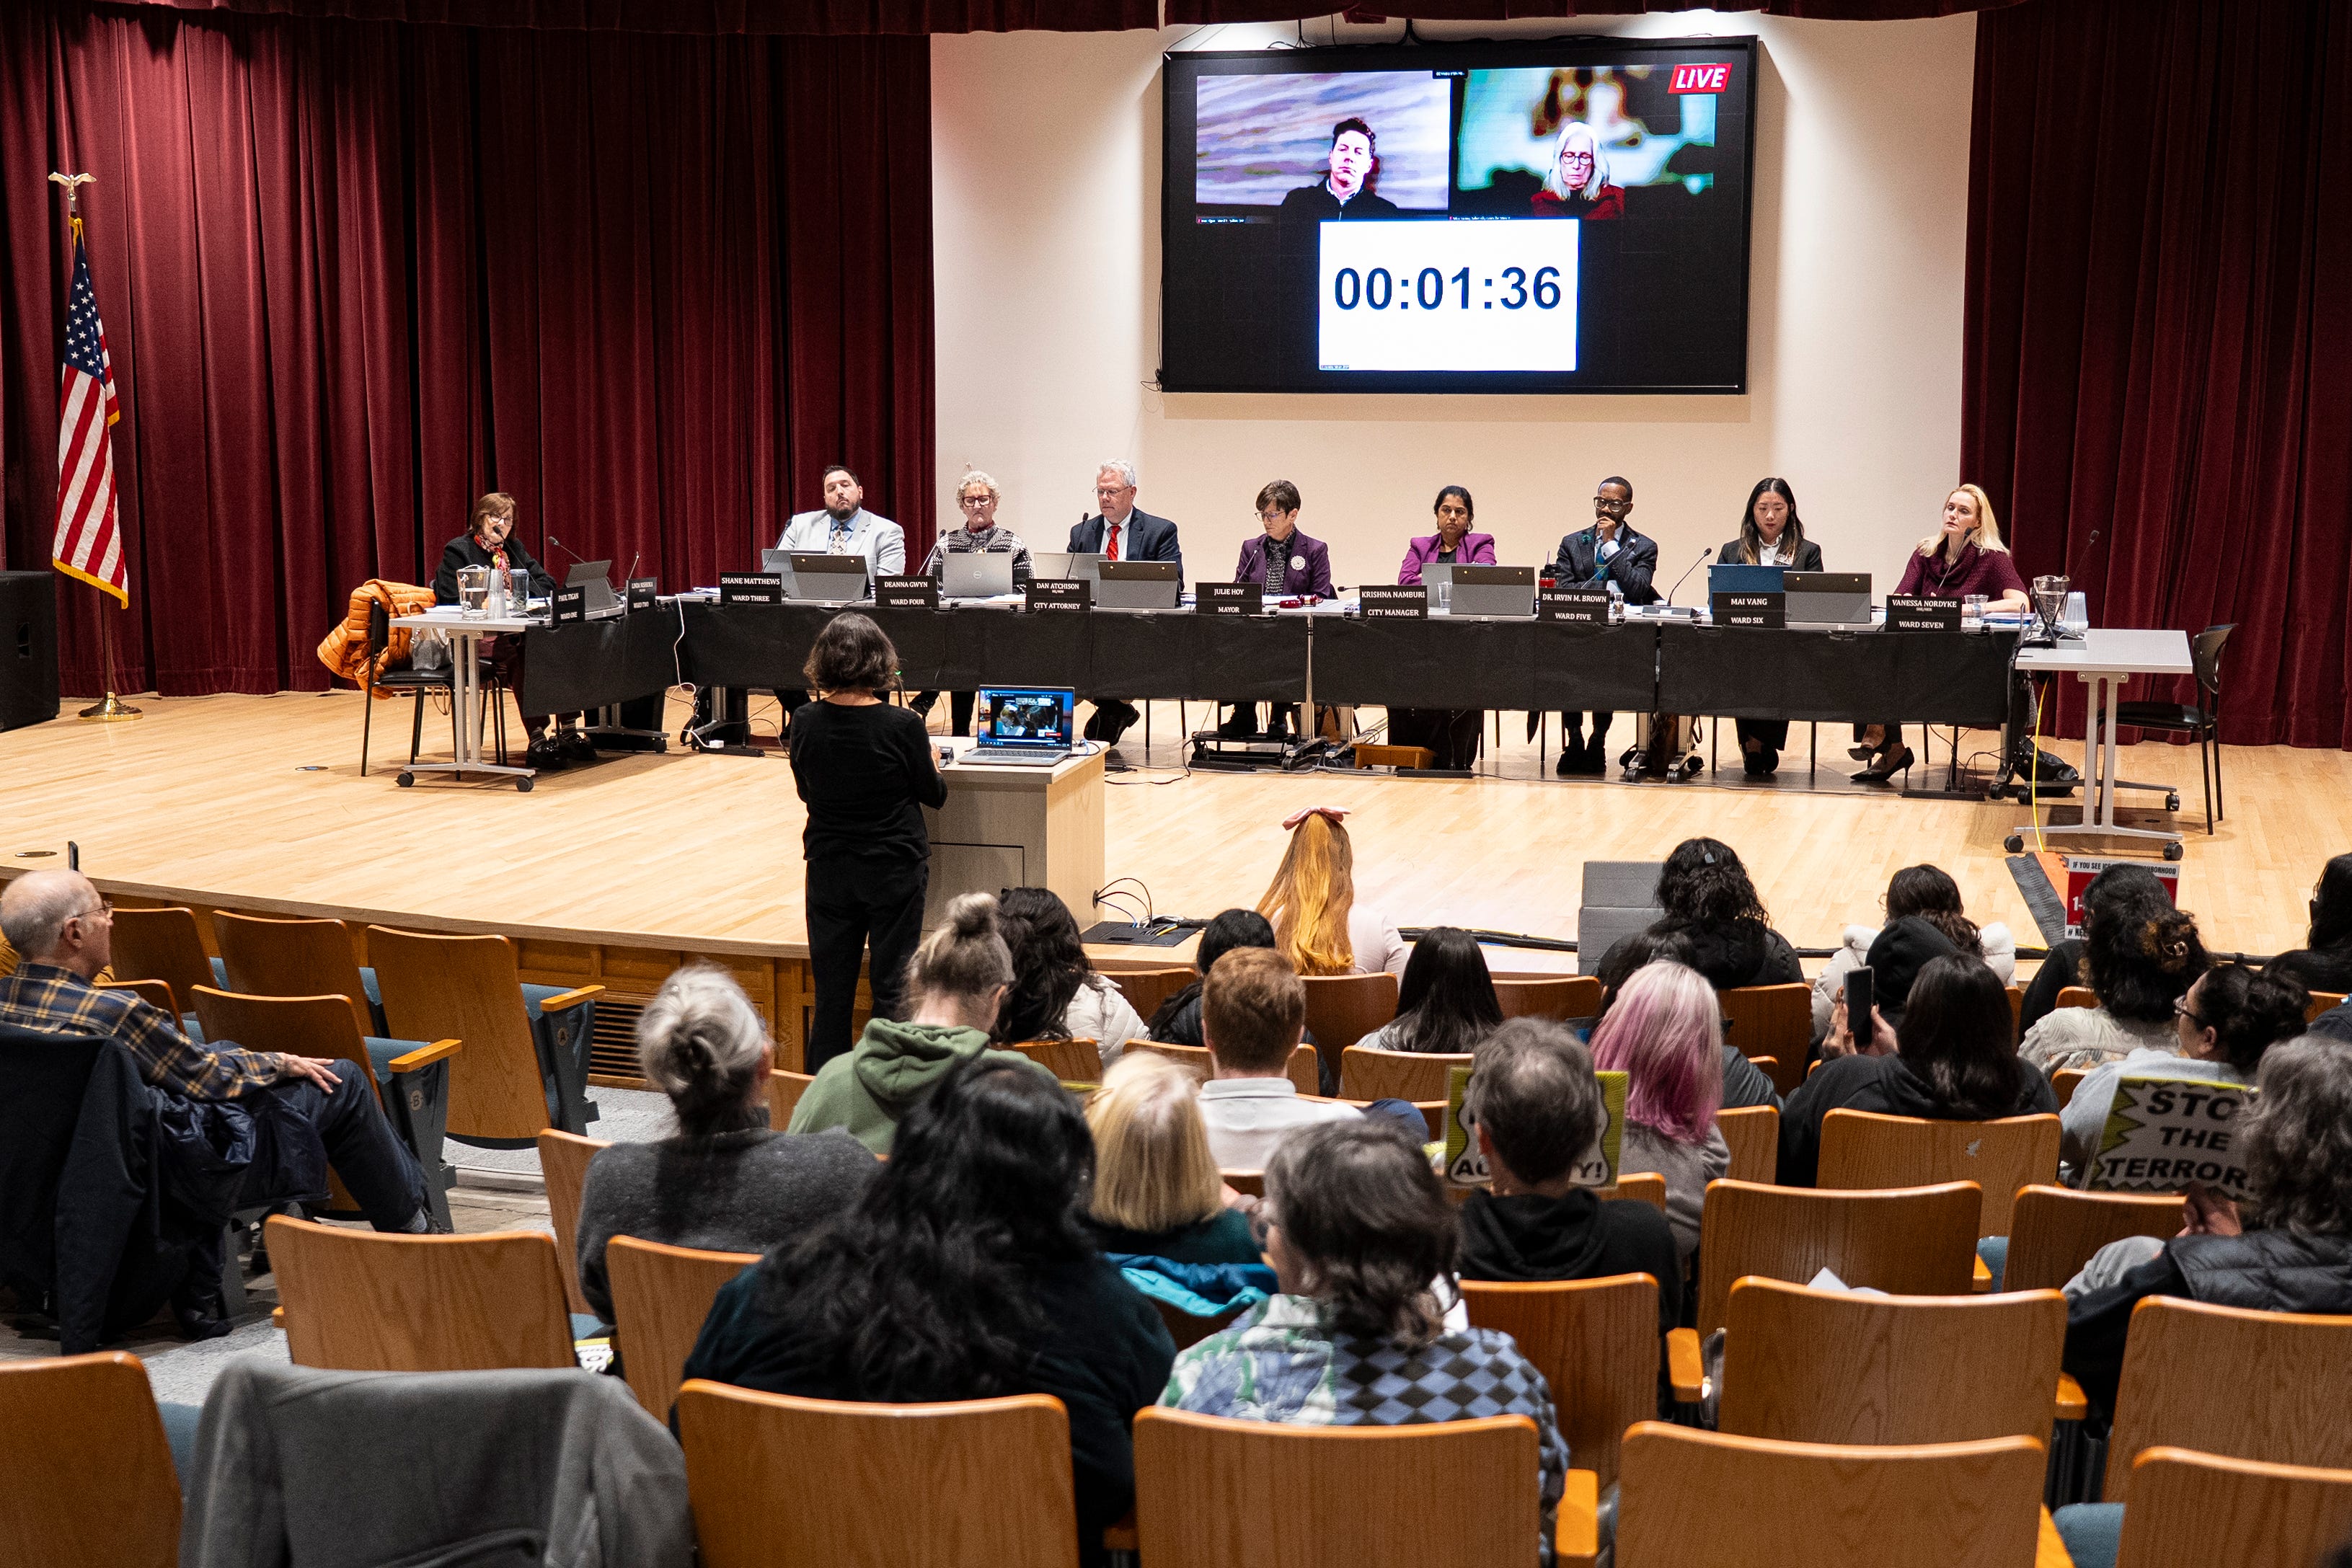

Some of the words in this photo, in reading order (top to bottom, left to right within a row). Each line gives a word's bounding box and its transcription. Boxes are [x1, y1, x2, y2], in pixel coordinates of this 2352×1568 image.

[1676, 68, 1726, 89] LIVE
[1335, 266, 1561, 310] 00:01:36
[2146, 1088, 2240, 1121] STO
[2159, 1126, 2232, 1151] THE
